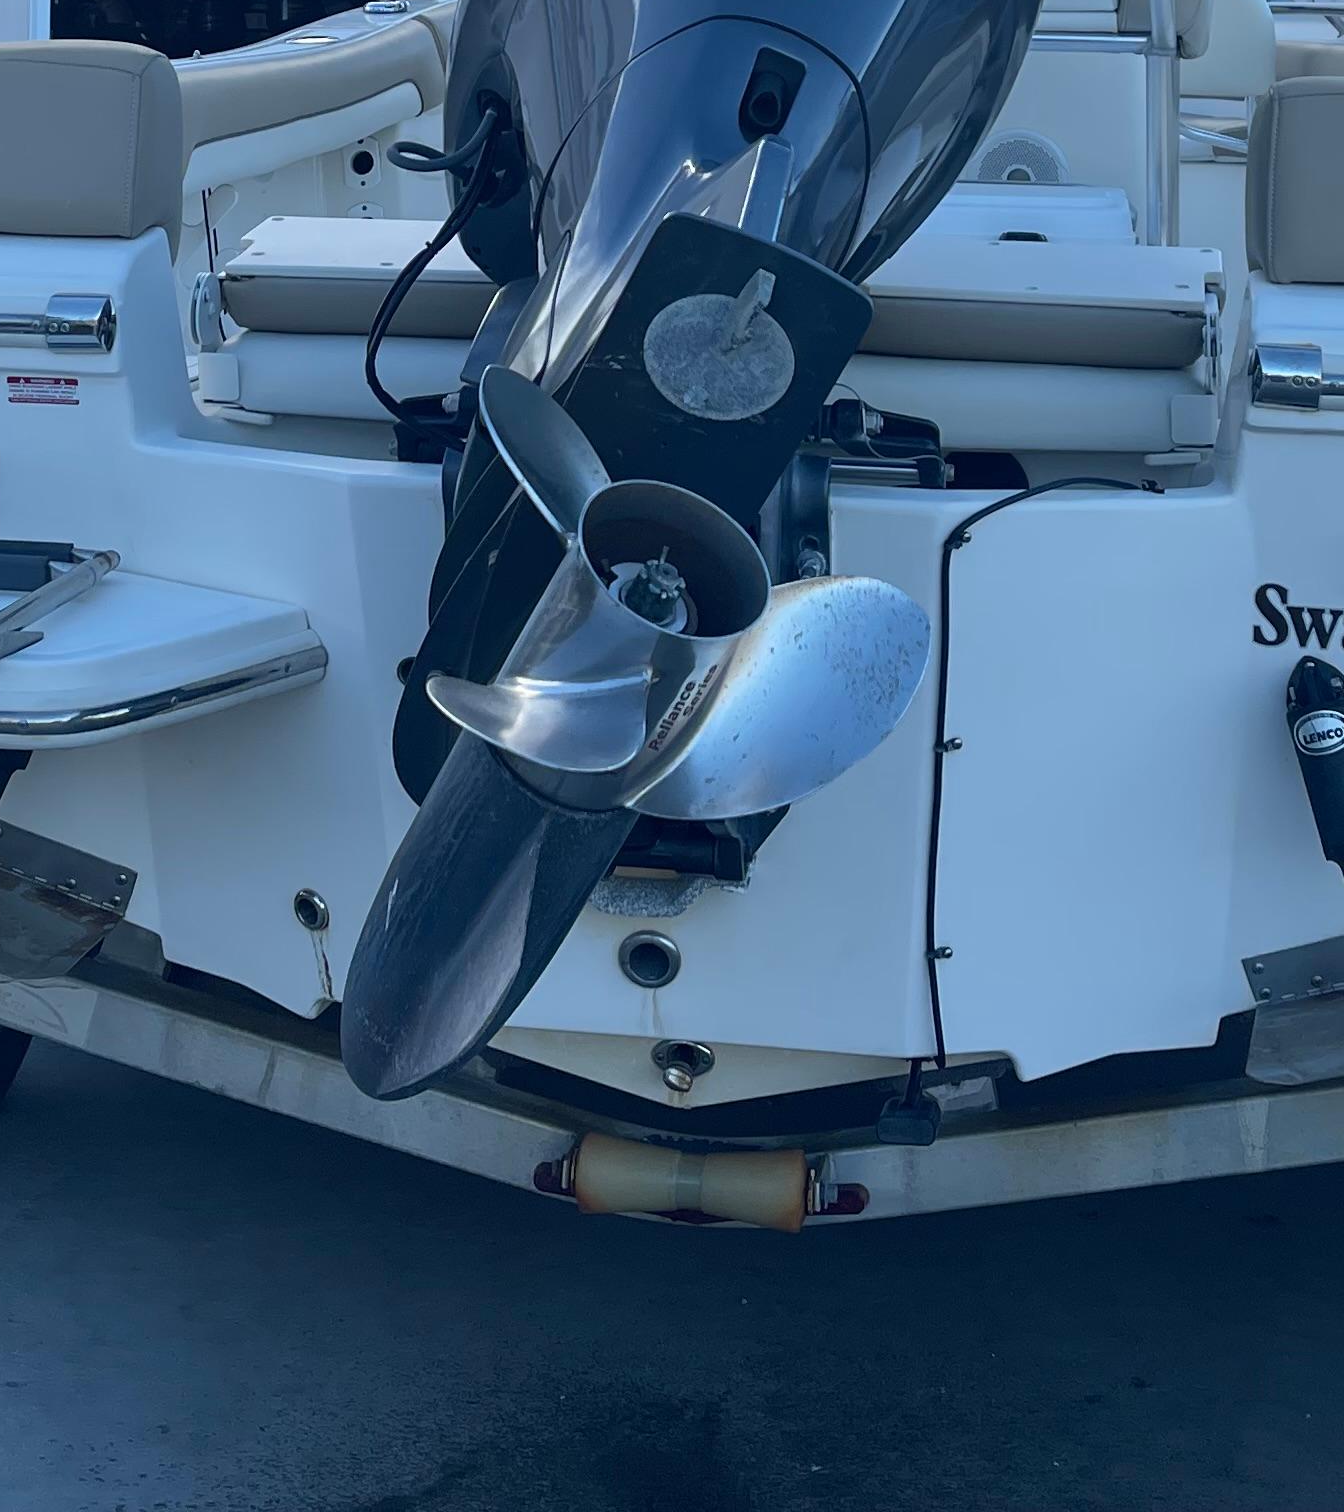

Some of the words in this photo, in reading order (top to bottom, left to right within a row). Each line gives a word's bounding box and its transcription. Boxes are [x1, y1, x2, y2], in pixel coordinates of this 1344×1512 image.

[648, 680, 696, 752] Reliance
[682, 663, 718, 718] Series
[1302, 727, 1344, 745] LENCO
